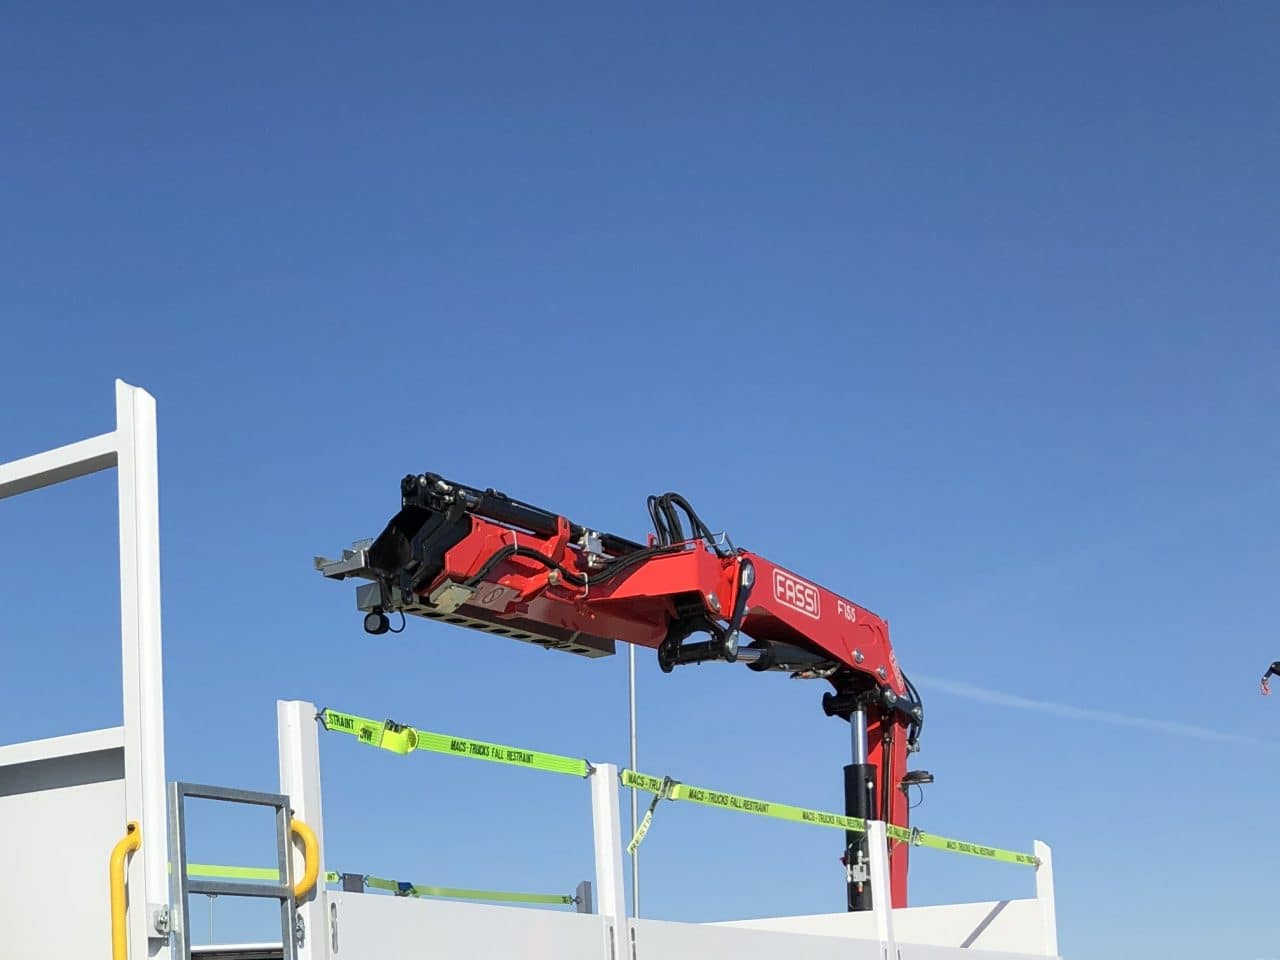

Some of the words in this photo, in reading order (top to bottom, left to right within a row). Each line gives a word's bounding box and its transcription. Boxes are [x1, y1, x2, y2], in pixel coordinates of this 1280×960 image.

[776, 575, 818, 614] FASSI
[491, 747, 504, 760] FALL
[628, 773, 645, 786] MACS
[688, 788, 704, 801] MACS
[708, 792, 729, 805] TRUCKS
[730, 797, 742, 808] FALL
[742, 799, 770, 813] RESTRAINT
